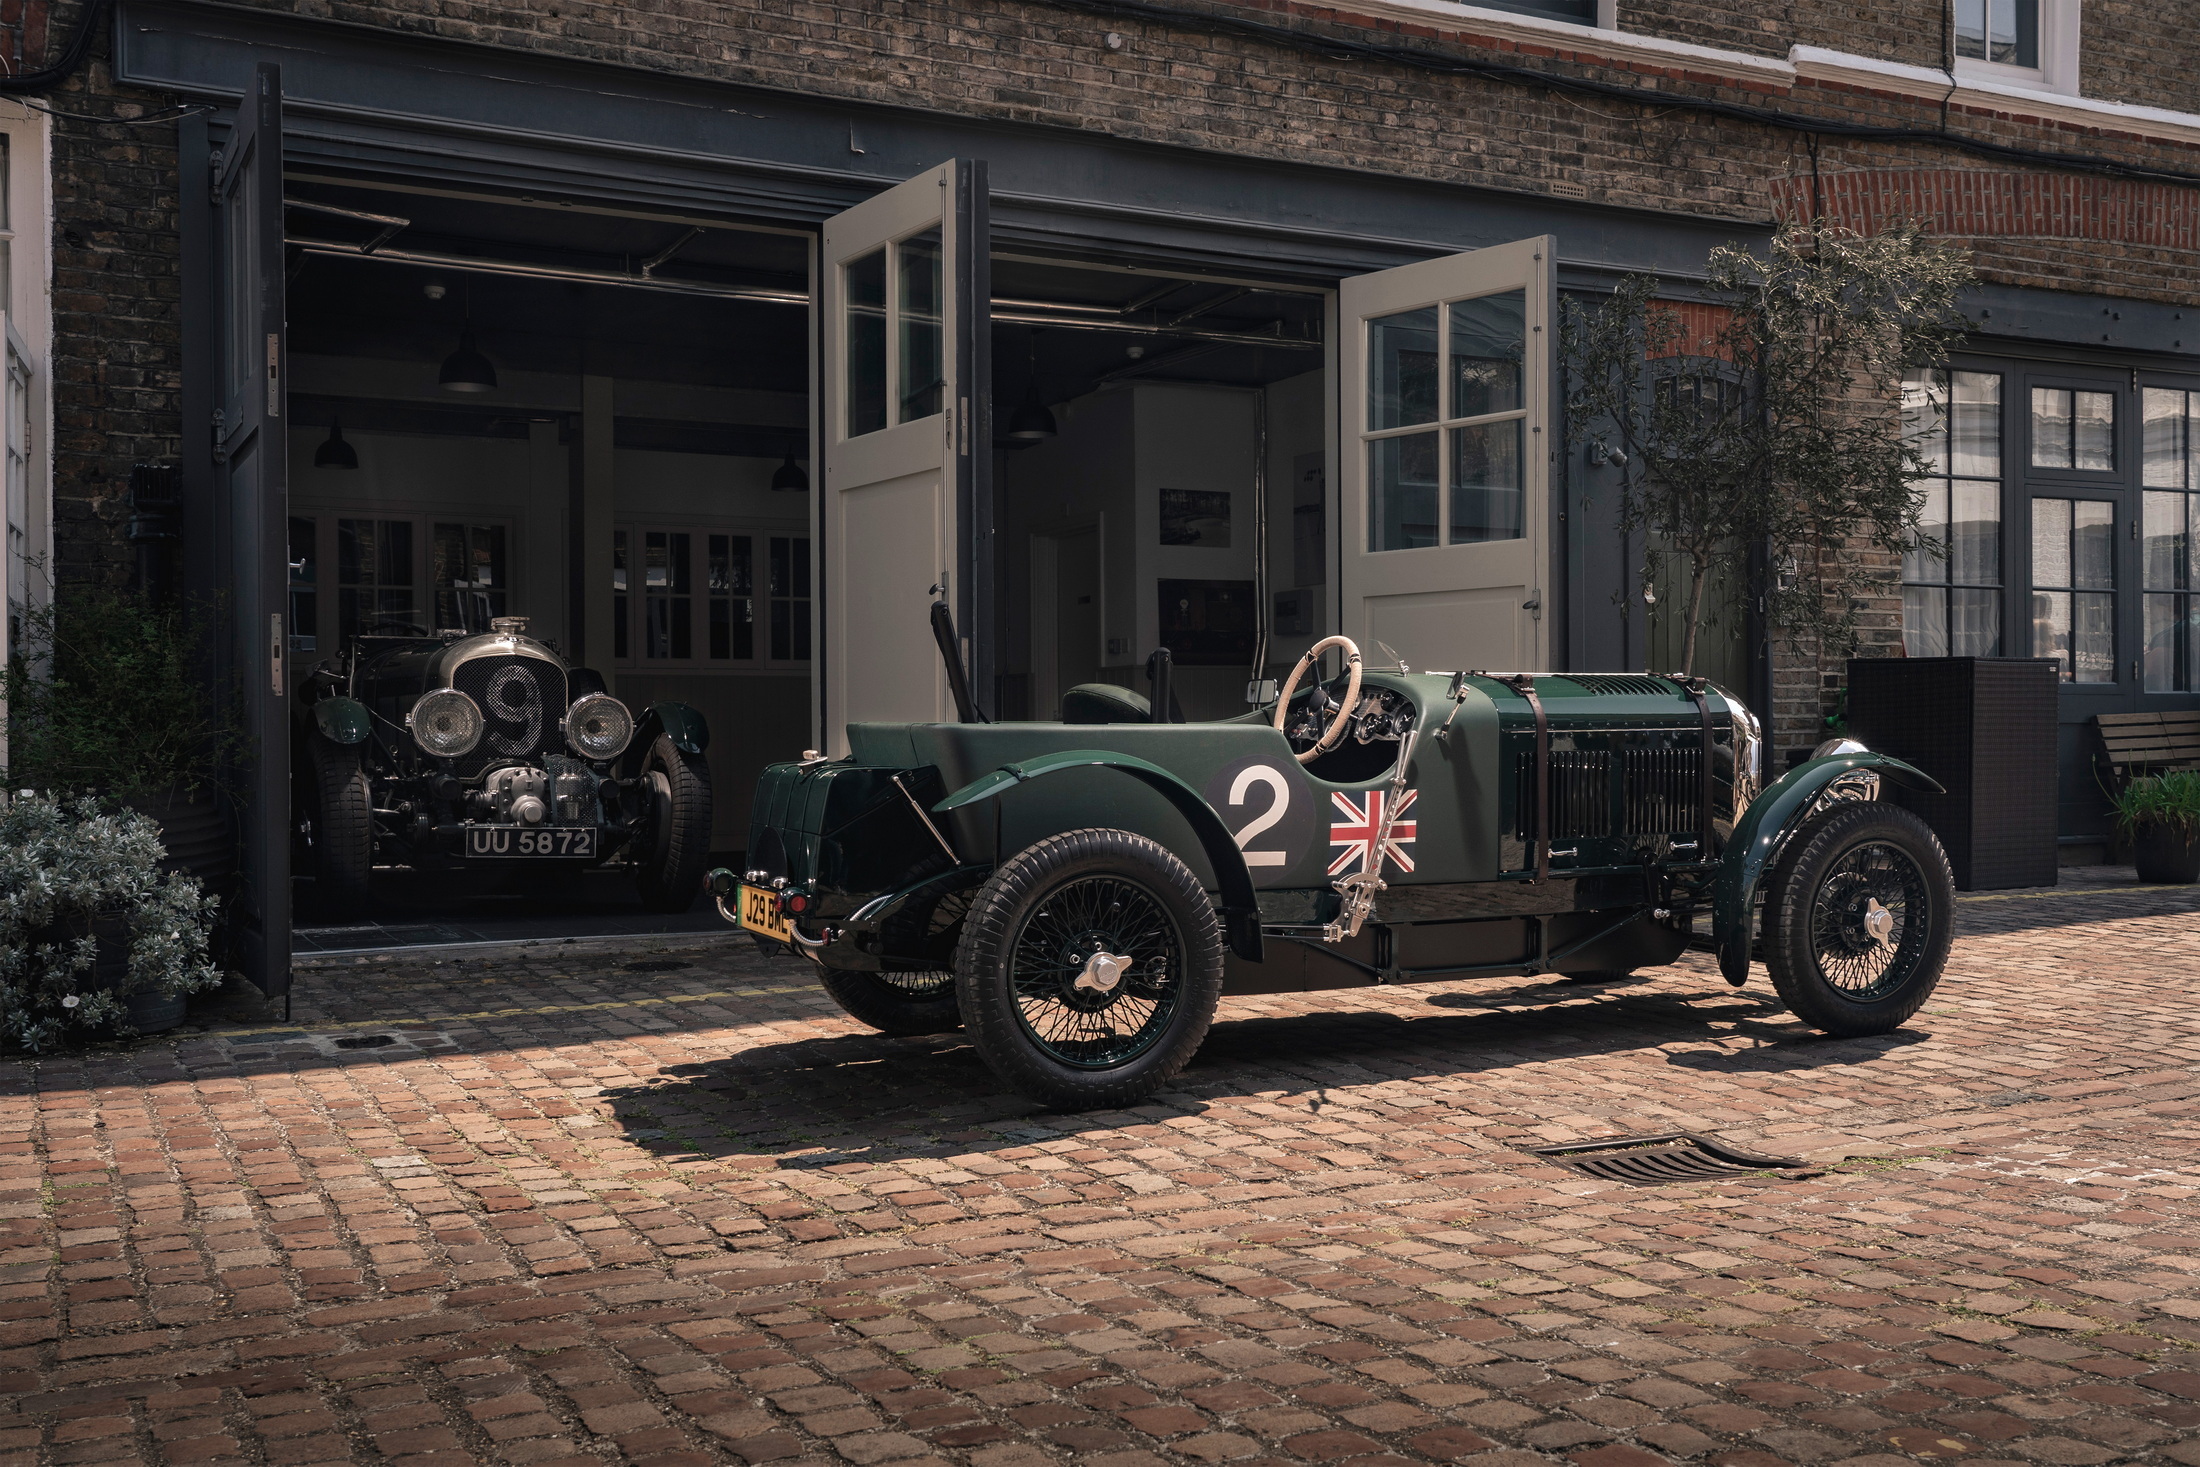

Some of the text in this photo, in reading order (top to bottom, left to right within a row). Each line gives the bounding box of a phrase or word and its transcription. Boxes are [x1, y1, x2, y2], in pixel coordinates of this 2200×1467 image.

[486, 665, 543, 756] 9
[473, 831, 591, 855] UU 5872
[1229, 764, 1290, 866] 2
[746, 892, 766, 927] J29
